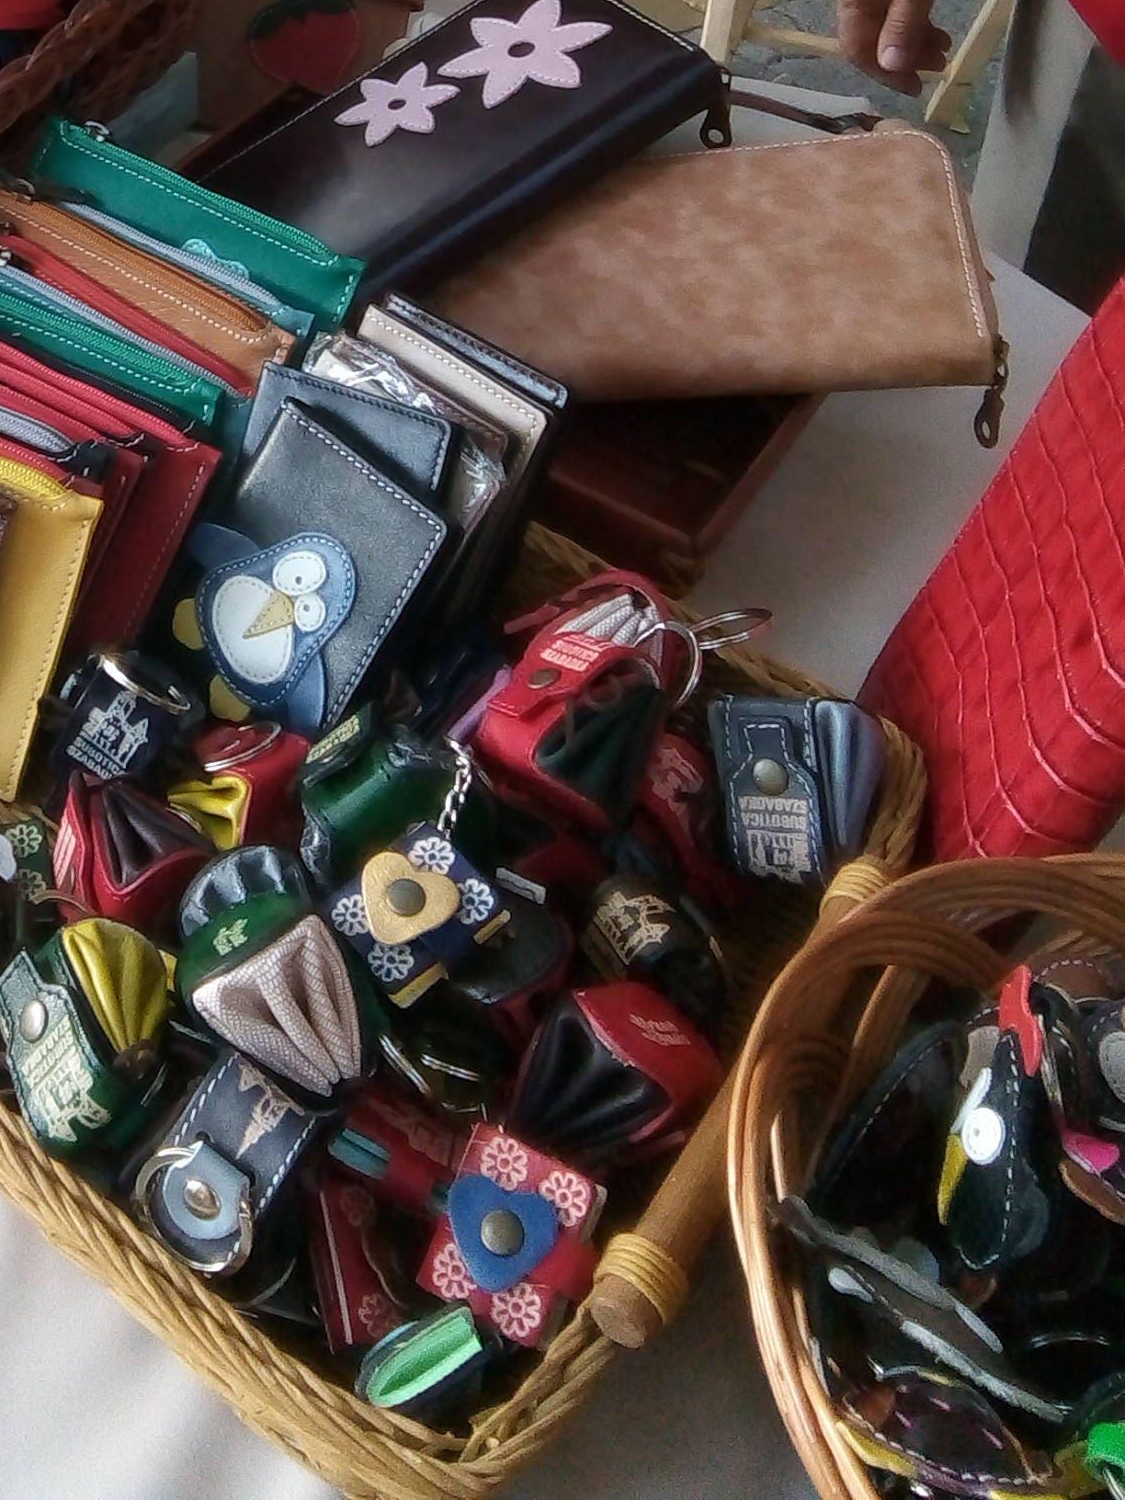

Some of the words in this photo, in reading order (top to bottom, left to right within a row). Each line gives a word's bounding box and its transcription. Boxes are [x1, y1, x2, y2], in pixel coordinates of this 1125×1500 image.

[65, 745, 113, 780] SZABAD
[738, 796, 808, 814] SZABADKA
[741, 812, 807, 832] SUBOTICA
